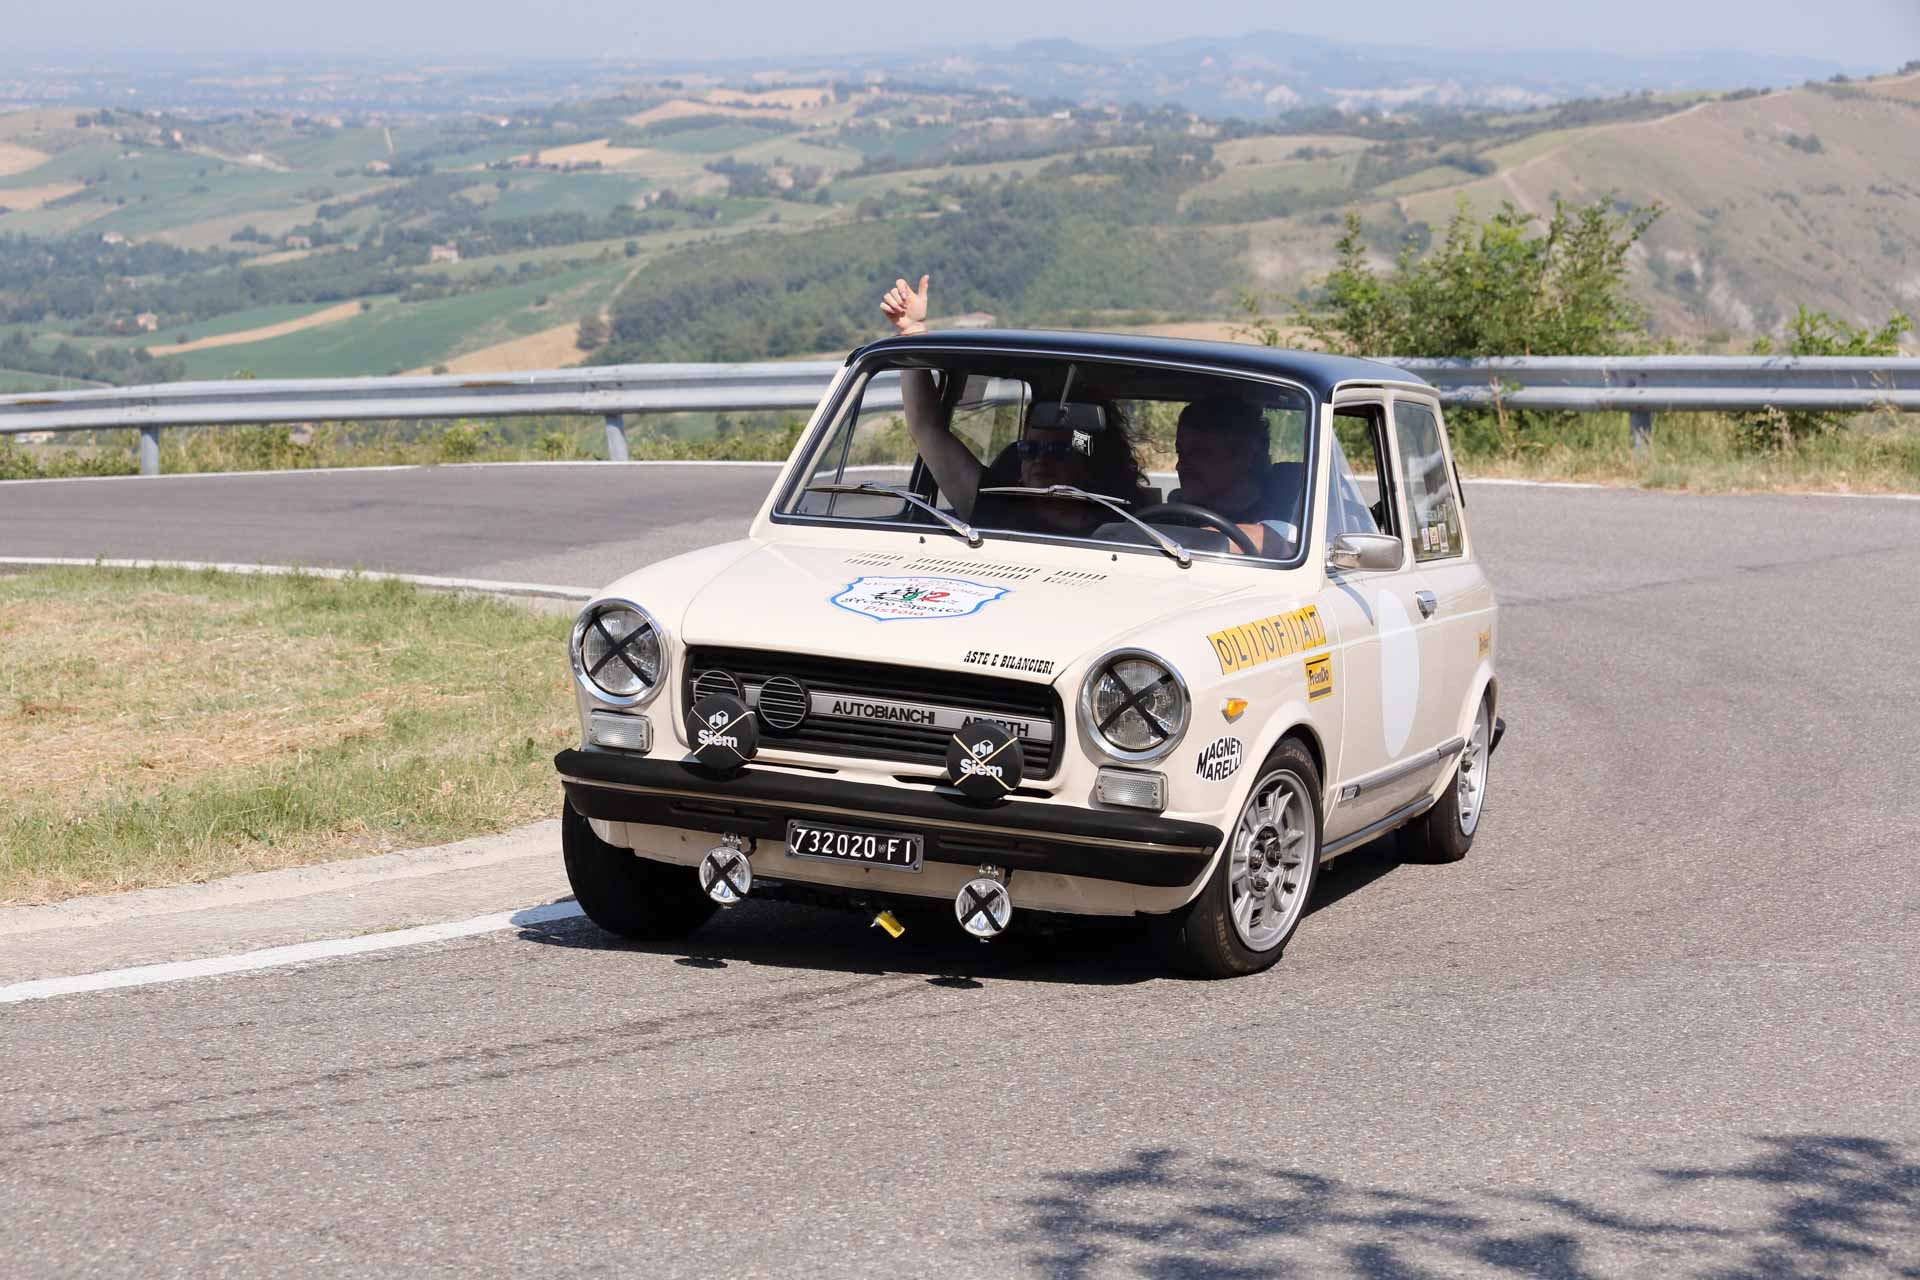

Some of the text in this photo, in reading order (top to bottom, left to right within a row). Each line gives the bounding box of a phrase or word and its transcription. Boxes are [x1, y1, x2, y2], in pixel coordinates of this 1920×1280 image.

[963, 650, 1055, 675] ASTE E BILANCIERI
[832, 701, 1029, 737] AUTOBIANCHI ATH
[698, 729, 738, 748] Siem
[960, 758, 1003, 778] Siem
[796, 828, 876, 858] 732020
